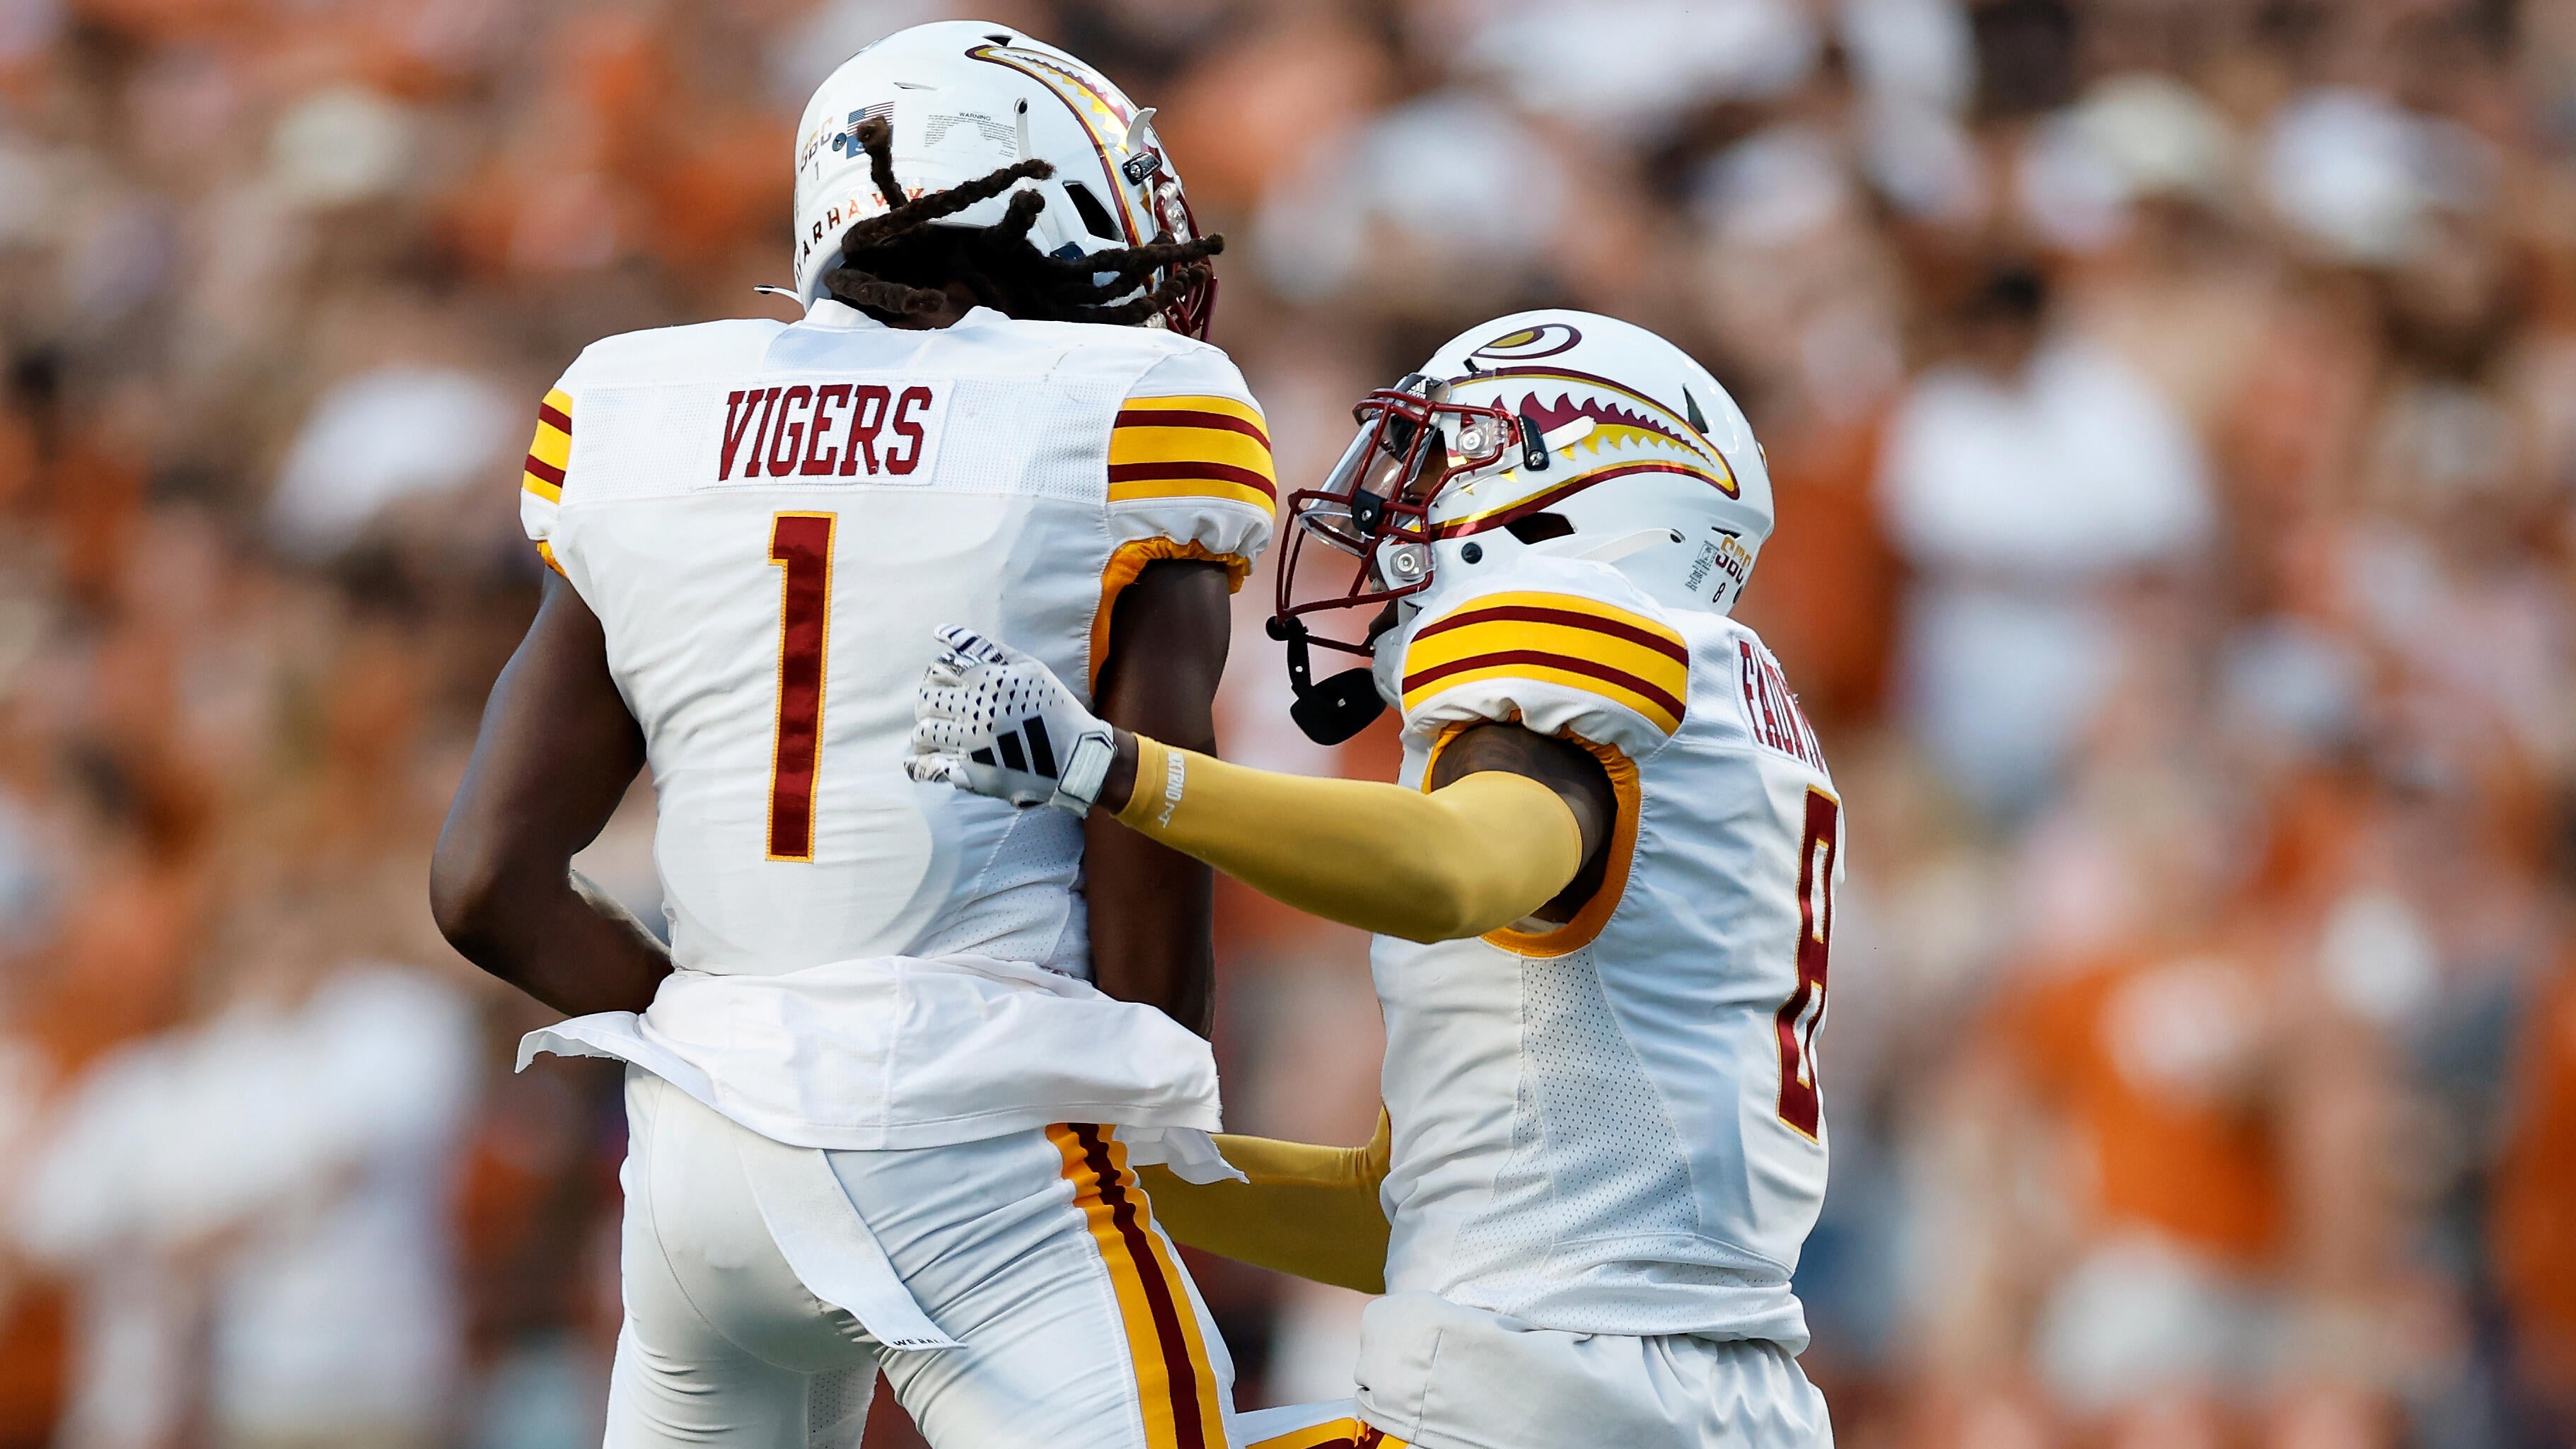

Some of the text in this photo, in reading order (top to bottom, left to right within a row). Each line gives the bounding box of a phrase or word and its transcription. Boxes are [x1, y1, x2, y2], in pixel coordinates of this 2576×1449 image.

[959, 112, 991, 121] WARNING
[815, 161, 819, 181] 1
[795, 187, 946, 283] WARHAWK
[719, 384, 932, 481] VIGERS
[1712, 582, 1726, 603] 8
[765, 510, 837, 863] 1
[1773, 784, 1839, 1145] 8
